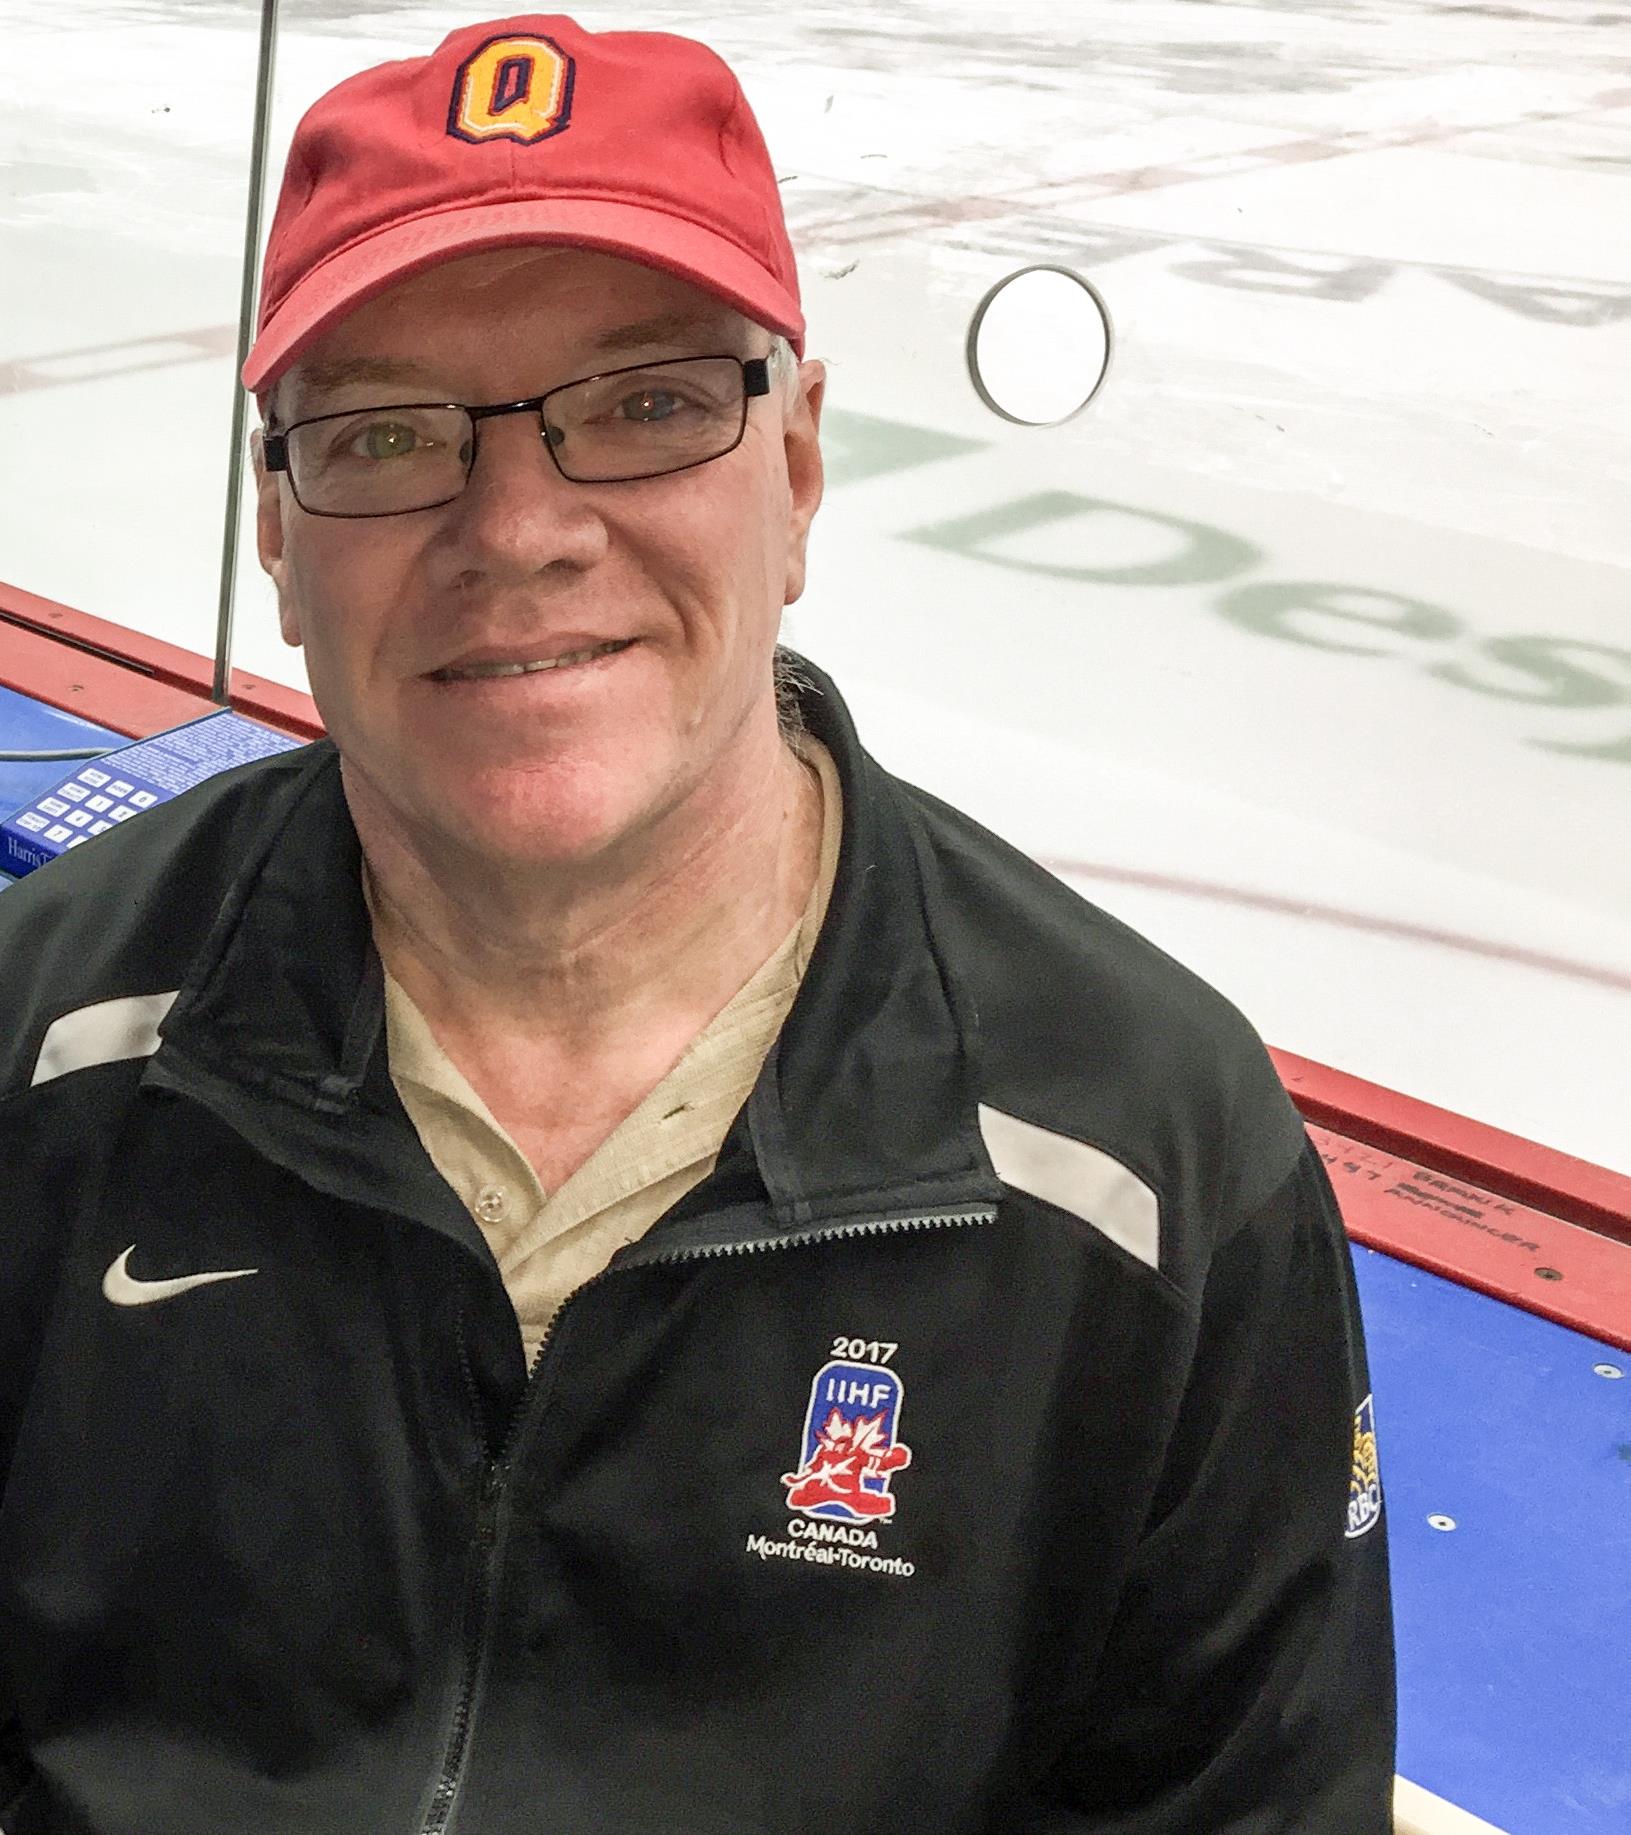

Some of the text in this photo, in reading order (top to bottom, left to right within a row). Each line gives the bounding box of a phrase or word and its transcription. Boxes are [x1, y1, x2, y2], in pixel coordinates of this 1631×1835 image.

[446, 32, 576, 147] Q
[830, 1336, 899, 1364] 2017
[826, 1378, 891, 1409] IIHF
[787, 1518, 878, 1549] CANADA
